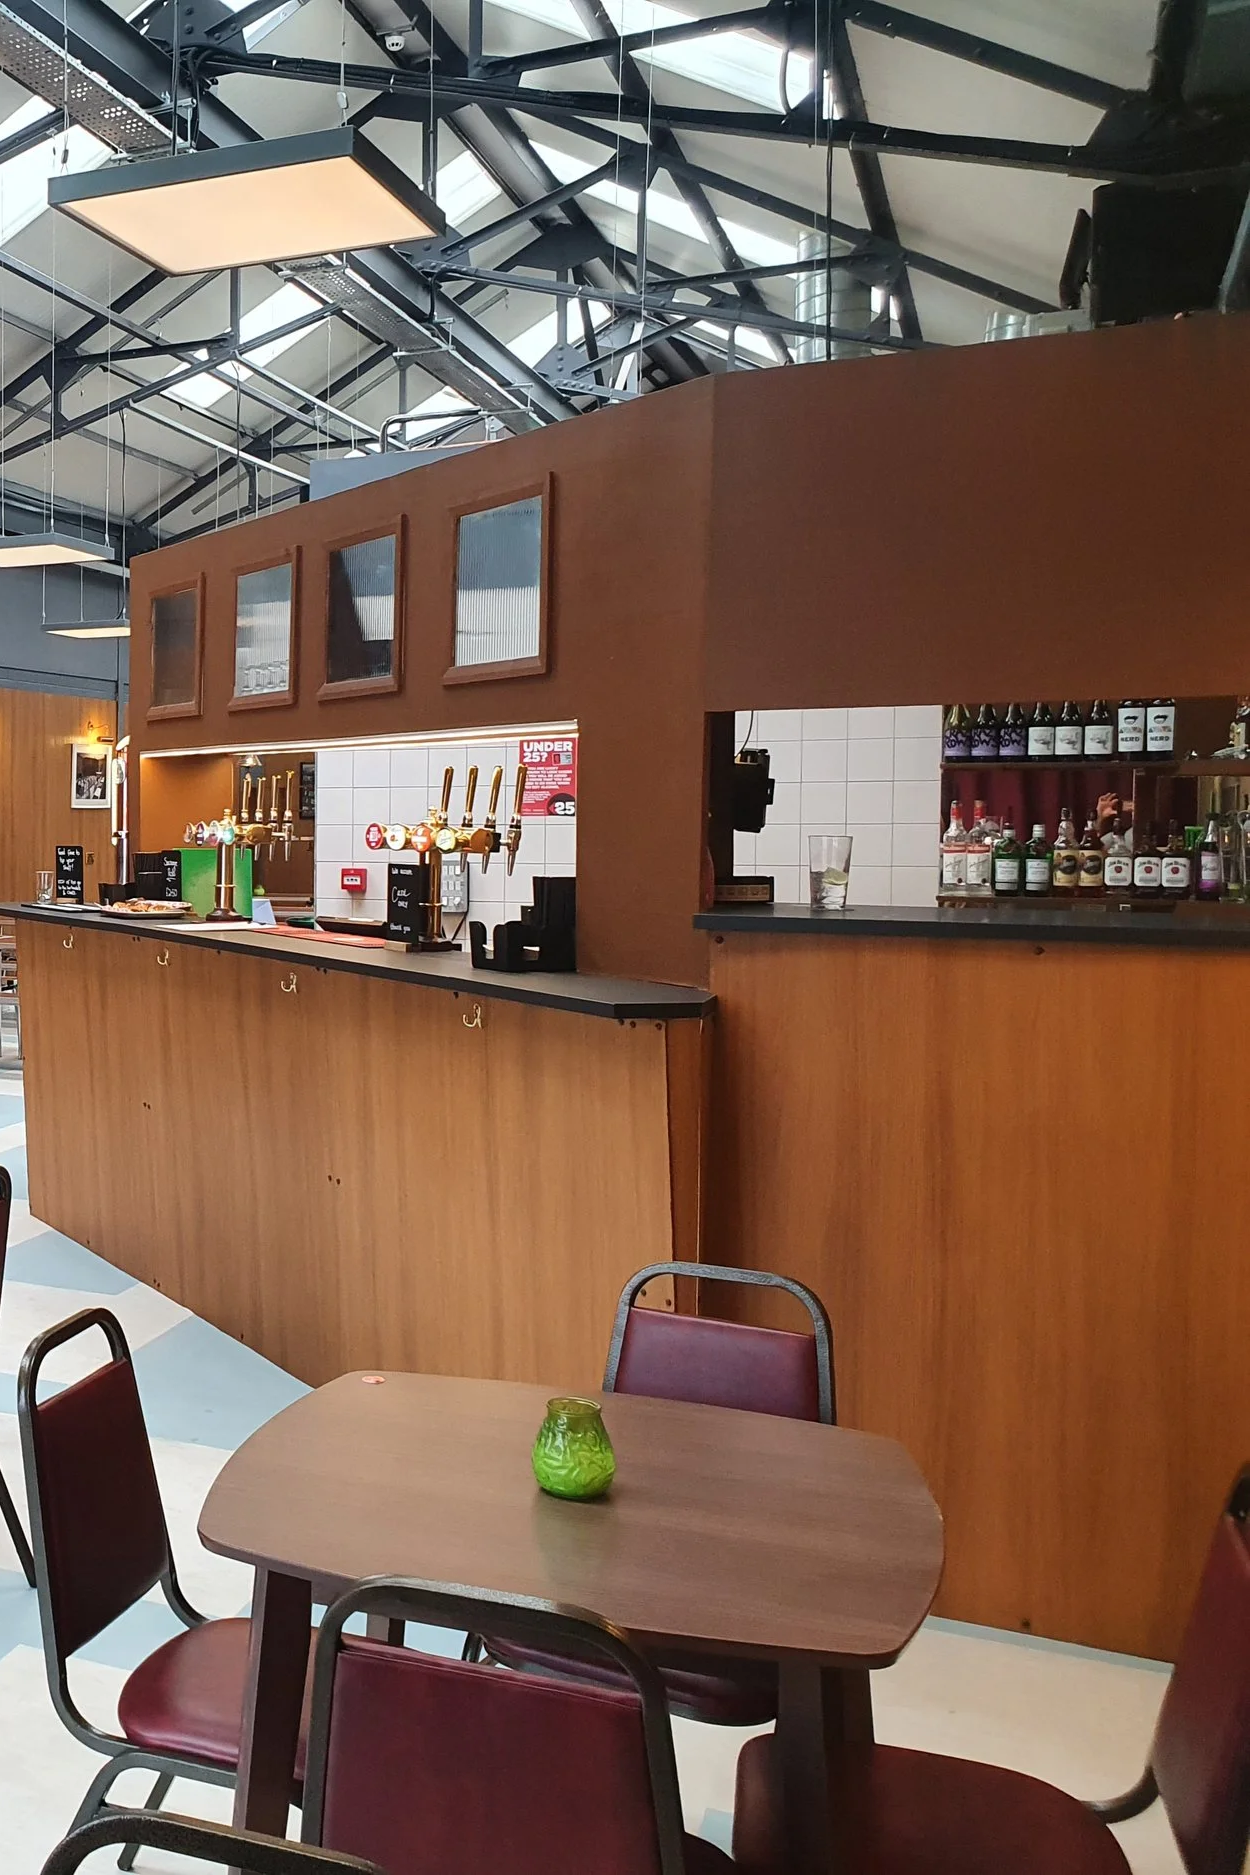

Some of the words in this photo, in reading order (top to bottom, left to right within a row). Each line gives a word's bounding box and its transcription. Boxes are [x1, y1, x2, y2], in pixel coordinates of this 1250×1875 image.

[522, 741, 573, 752] UNDER
[522, 752, 548, 763] 25?
[554, 801, 575, 816] 25
